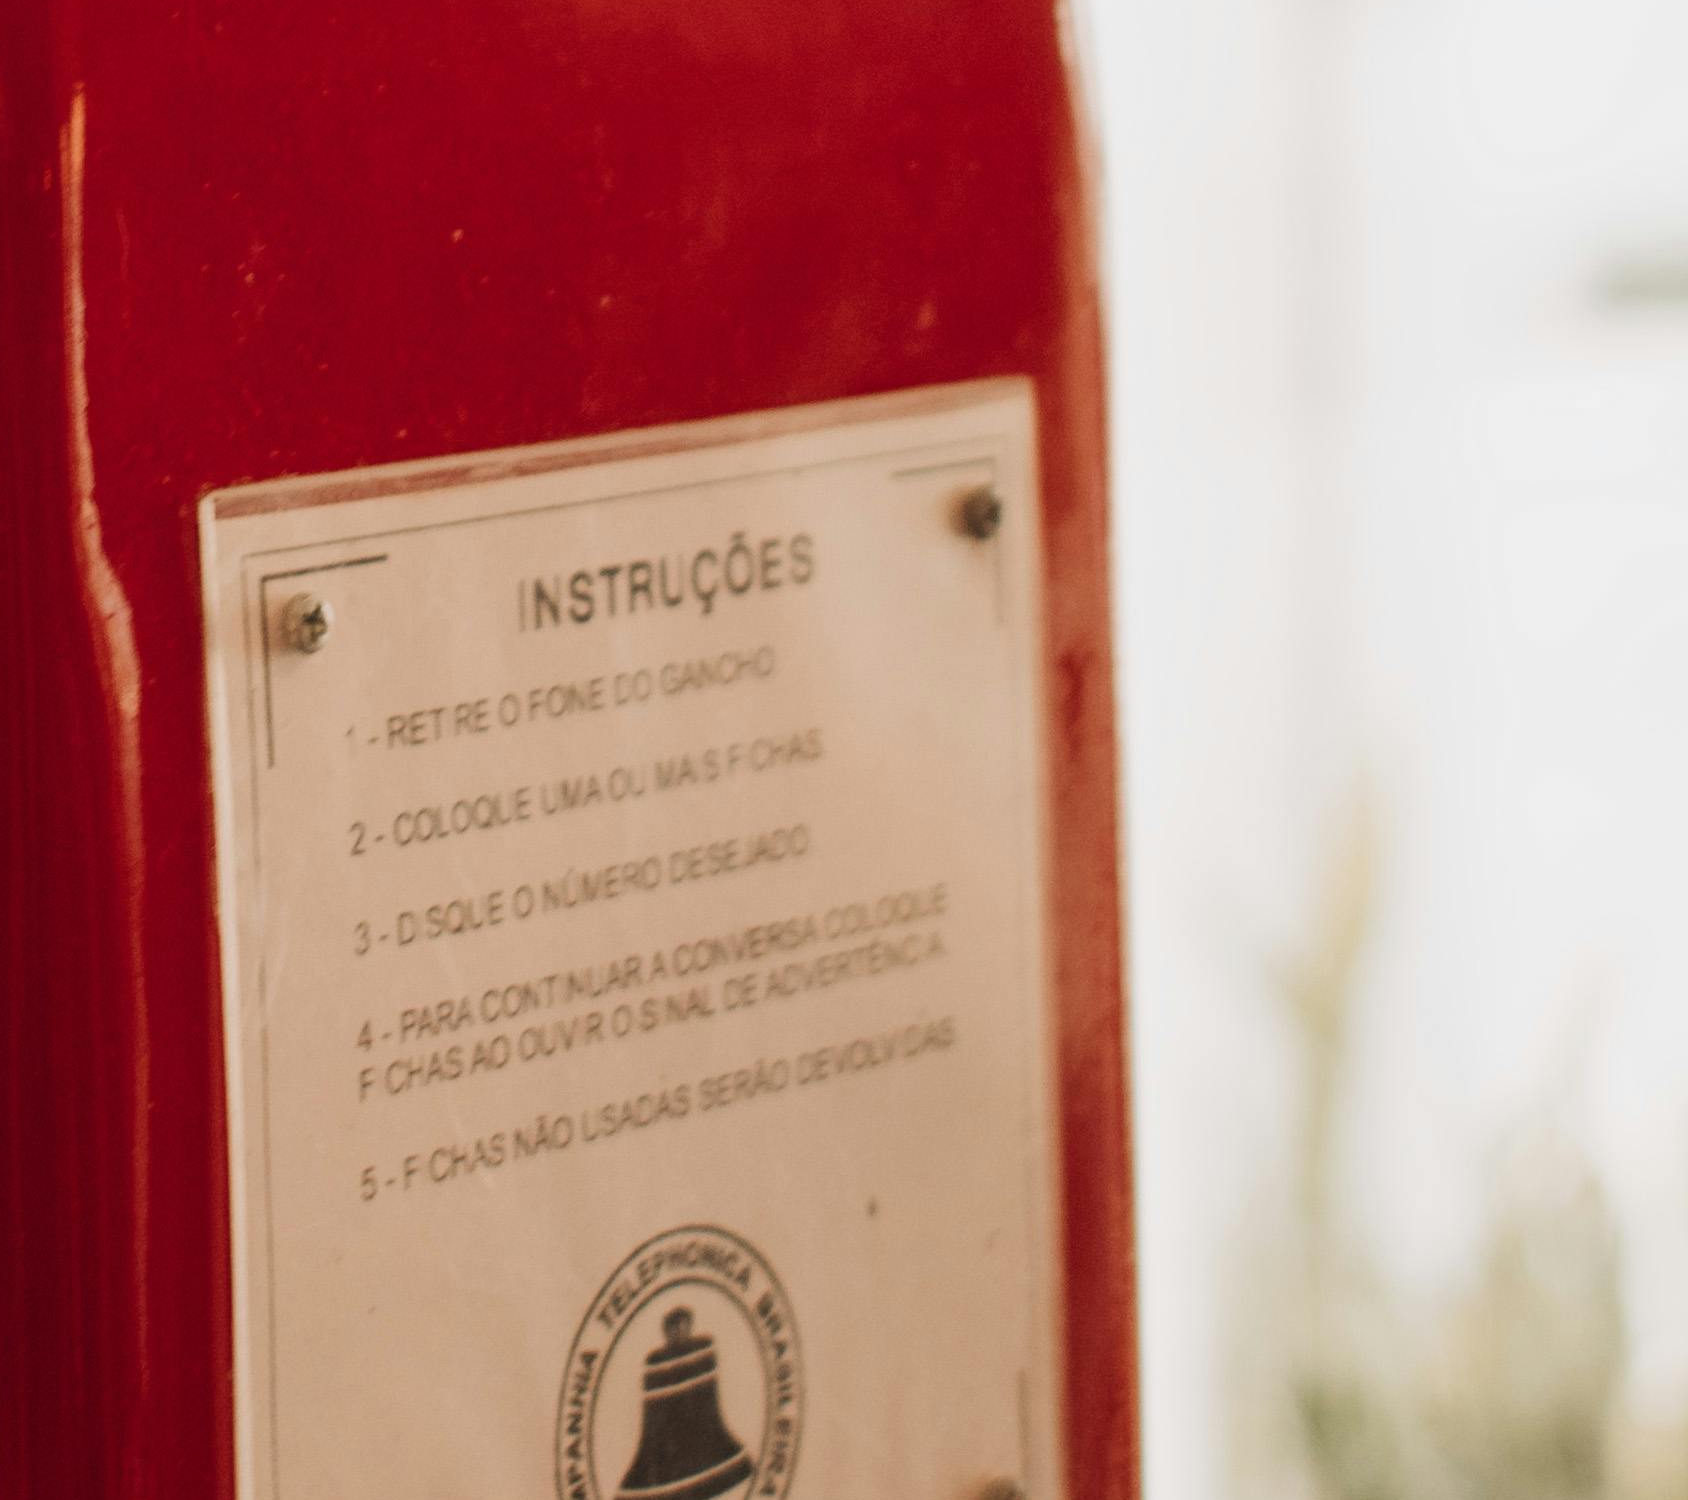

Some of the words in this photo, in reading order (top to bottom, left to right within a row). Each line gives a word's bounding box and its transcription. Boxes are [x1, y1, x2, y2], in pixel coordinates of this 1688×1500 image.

[518, 530, 813, 632] INSTRUÇÕES
[387, 698, 490, 749] RETRE
[498, 692, 521, 727] O
[528, 677, 604, 722] FONE
[615, 668, 652, 706] DO
[661, 645, 776, 696] GANCHO
[349, 820, 366, 857] 2
[393, 786, 531, 848] COLOQUE
[539, 774, 602, 815] UMA
[607, 763, 647, 802] OU
[654, 747, 720, 791] MAS
[727, 727, 824, 773] FCHAS
[353, 919, 371, 957] 3
[397, 890, 505, 947] DSQUE
[513, 884, 534, 919] O
[542, 855, 661, 912] NÚMERO
[669, 823, 809, 885] DESEJADO
[356, 1018, 373, 1051] 4
[400, 996, 475, 1044] PARA
[480, 955, 643, 1023] CONTNUAR
[650, 950, 667, 983] A
[672, 914, 817, 976] CONVERSA
[823, 881, 948, 942] COLOQUE
[358, 1044, 464, 1104] FCHAS
[470, 1034, 511, 1074] AO
[518, 1011, 604, 1063] OUVR
[612, 1003, 634, 1038] O
[639, 985, 716, 1032] SNAL
[722, 972, 758, 1012] DE
[765, 931, 948, 999] ADVERTÊNCA
[360, 1164, 378, 1201] 5
[403, 1132, 506, 1191] FCHAS
[512, 1113, 574, 1160] NÃO
[582, 1081, 692, 1143] USADAS
[698, 1056, 791, 1113] SERÃO
[796, 1014, 957, 1087] DEVOLVDAS
